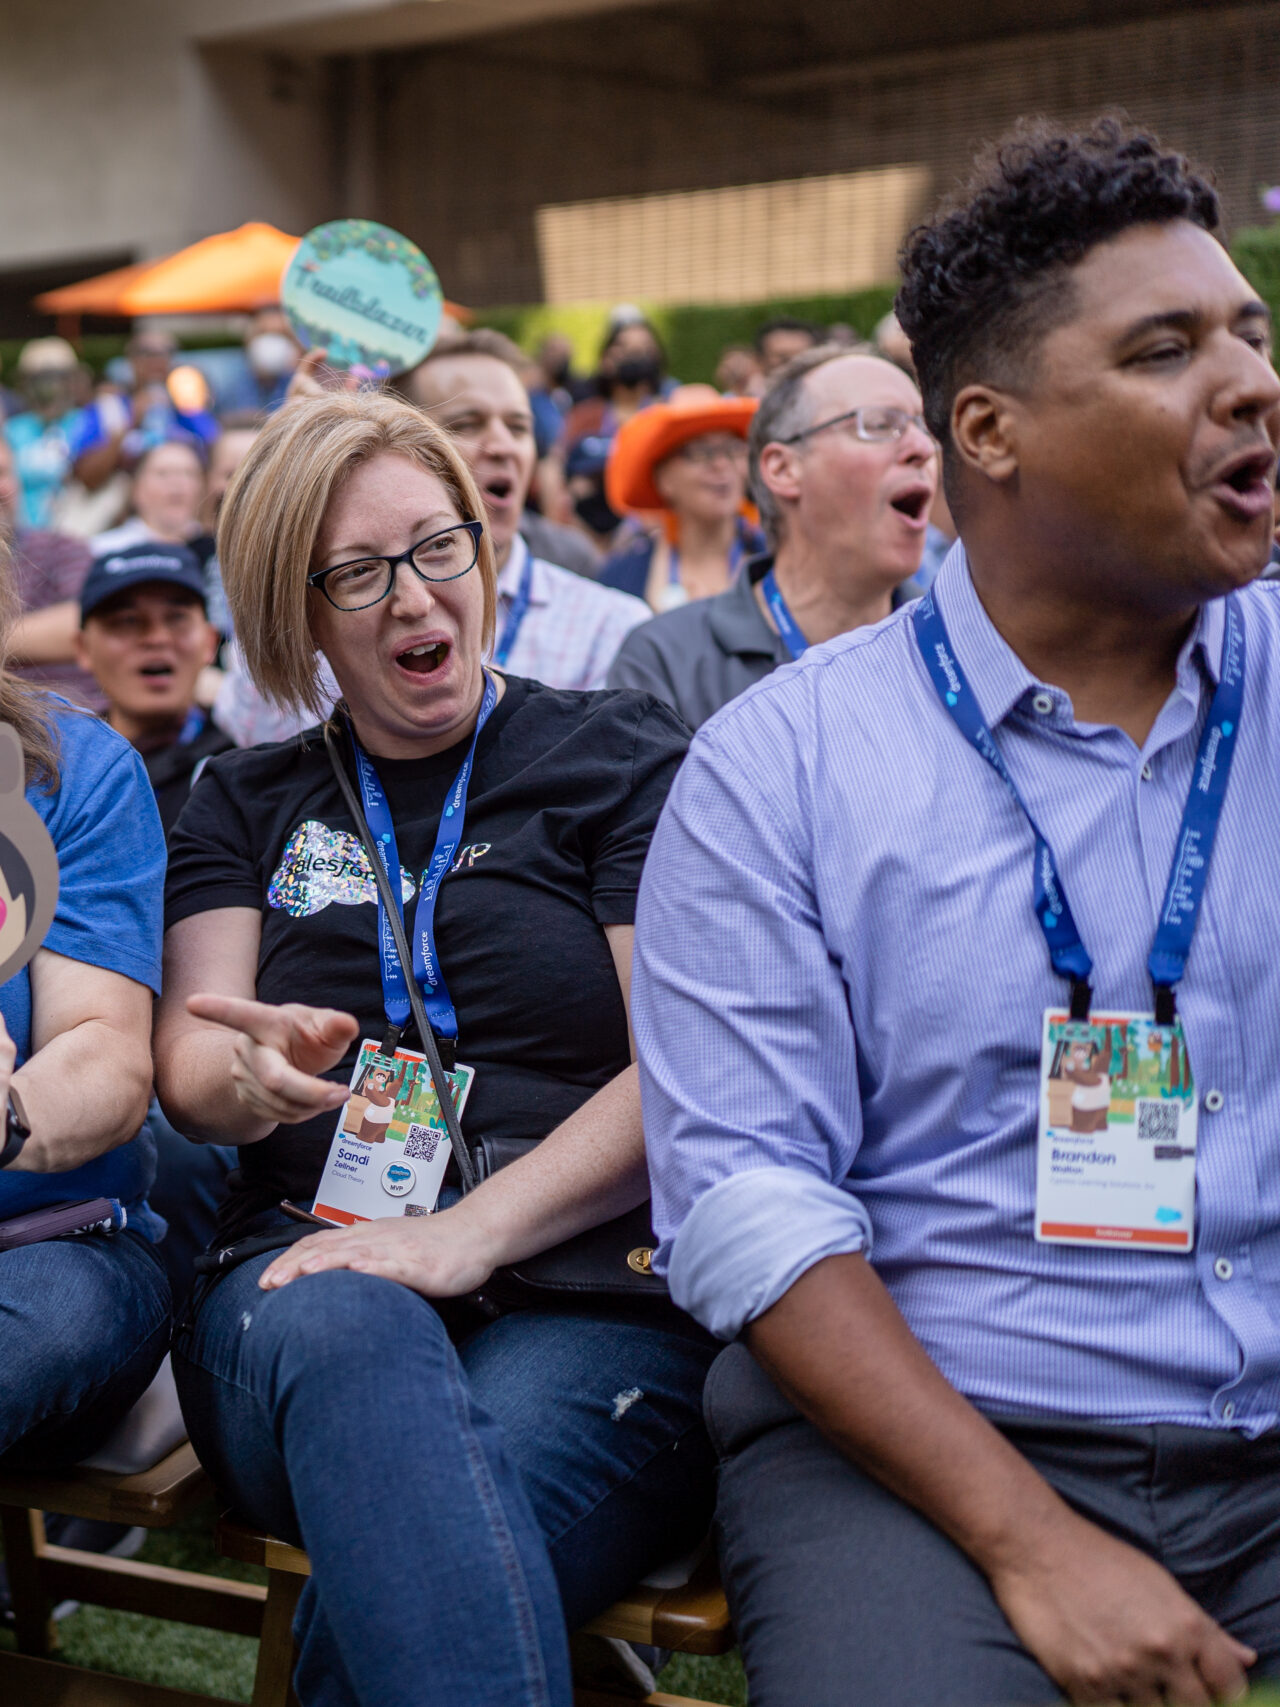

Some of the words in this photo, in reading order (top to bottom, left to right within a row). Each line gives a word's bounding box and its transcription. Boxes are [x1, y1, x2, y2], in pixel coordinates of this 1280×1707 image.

[452, 762, 469, 808] dreamforce
[285, 853, 377, 882] salesfor
[422, 930, 438, 987] dreamforce
[341, 1138, 372, 1151] dreamforce
[337, 1148, 370, 1166] Sandi
[1051, 1148, 1116, 1166] Brandon
[331, 1169, 347, 1179] Cloud
[334, 1160, 358, 1173] Zellner
[390, 1184, 404, 1192] MVP
